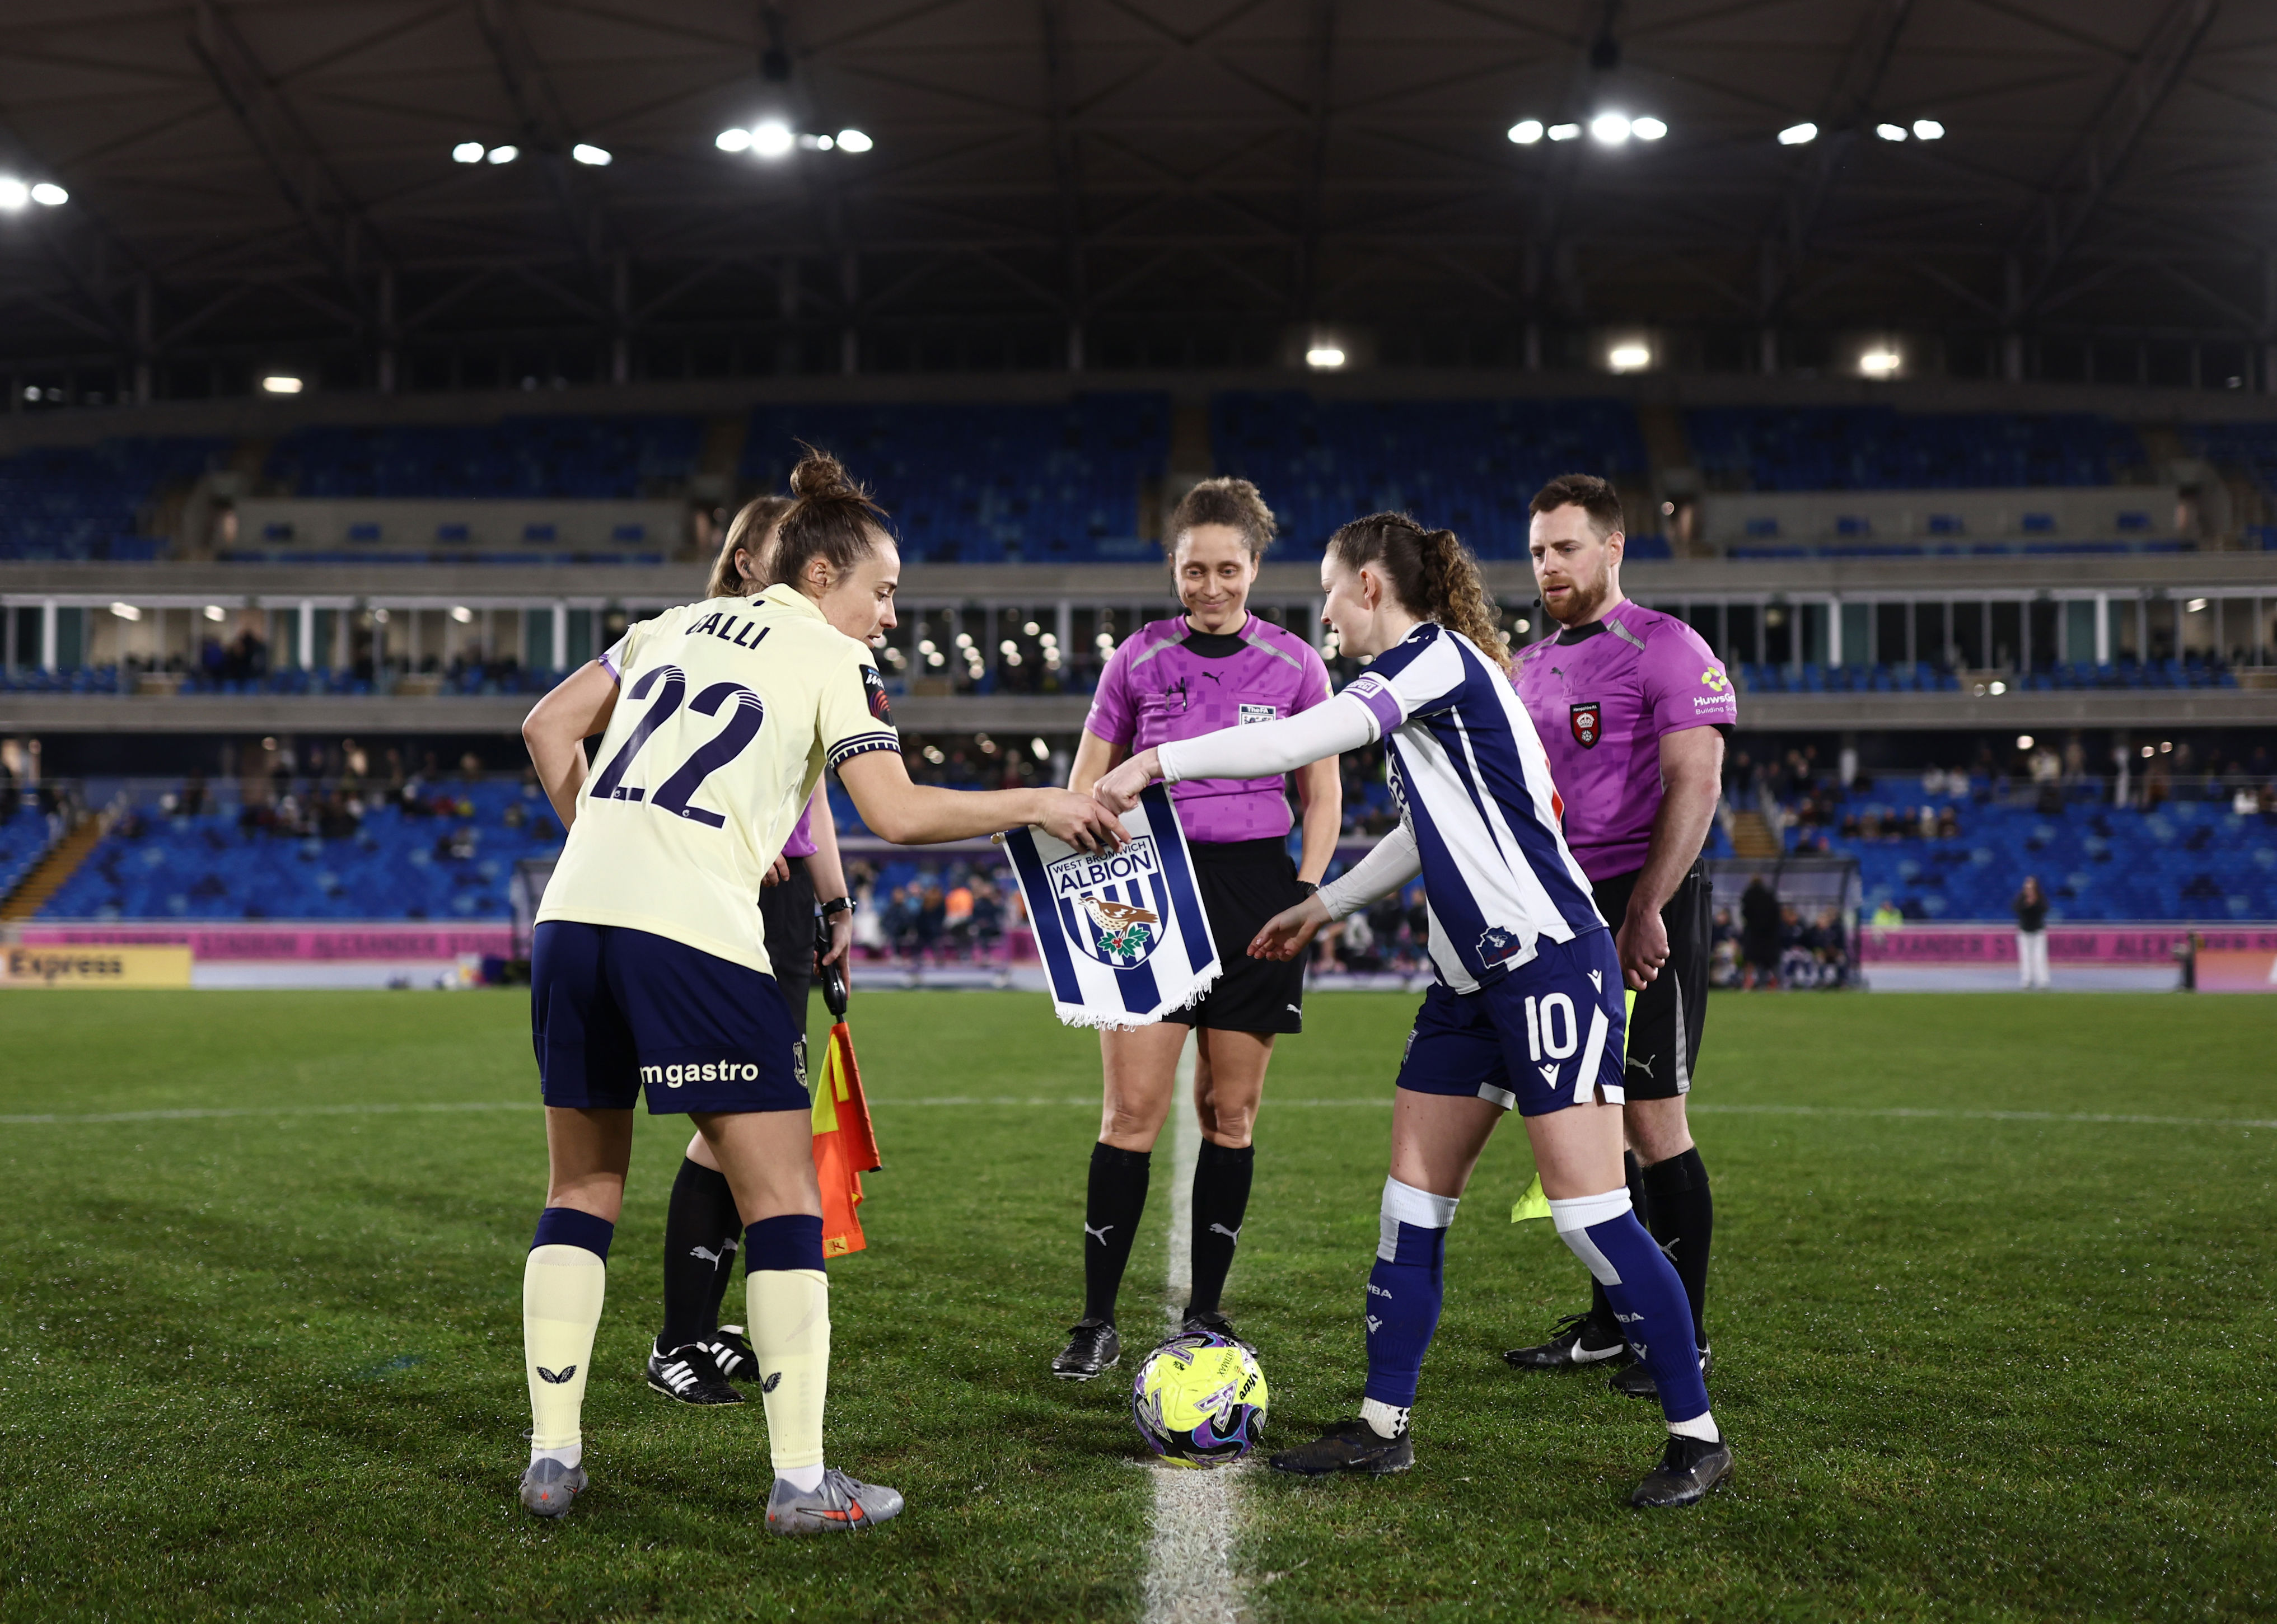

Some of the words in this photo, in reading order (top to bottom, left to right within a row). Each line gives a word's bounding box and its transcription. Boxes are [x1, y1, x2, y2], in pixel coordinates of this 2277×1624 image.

[1695, 706, 1724, 715] Building
[590, 664, 764, 829] 22
[1053, 859, 1082, 874] WEST
[1086, 841, 1146, 865] BROMWICH
[1061, 850, 1152, 894] ALBION
[8, 949, 123, 986] Express
[1525, 993, 1578, 1061] 10
[1217, 1349, 1234, 1377] ULTIMAX
